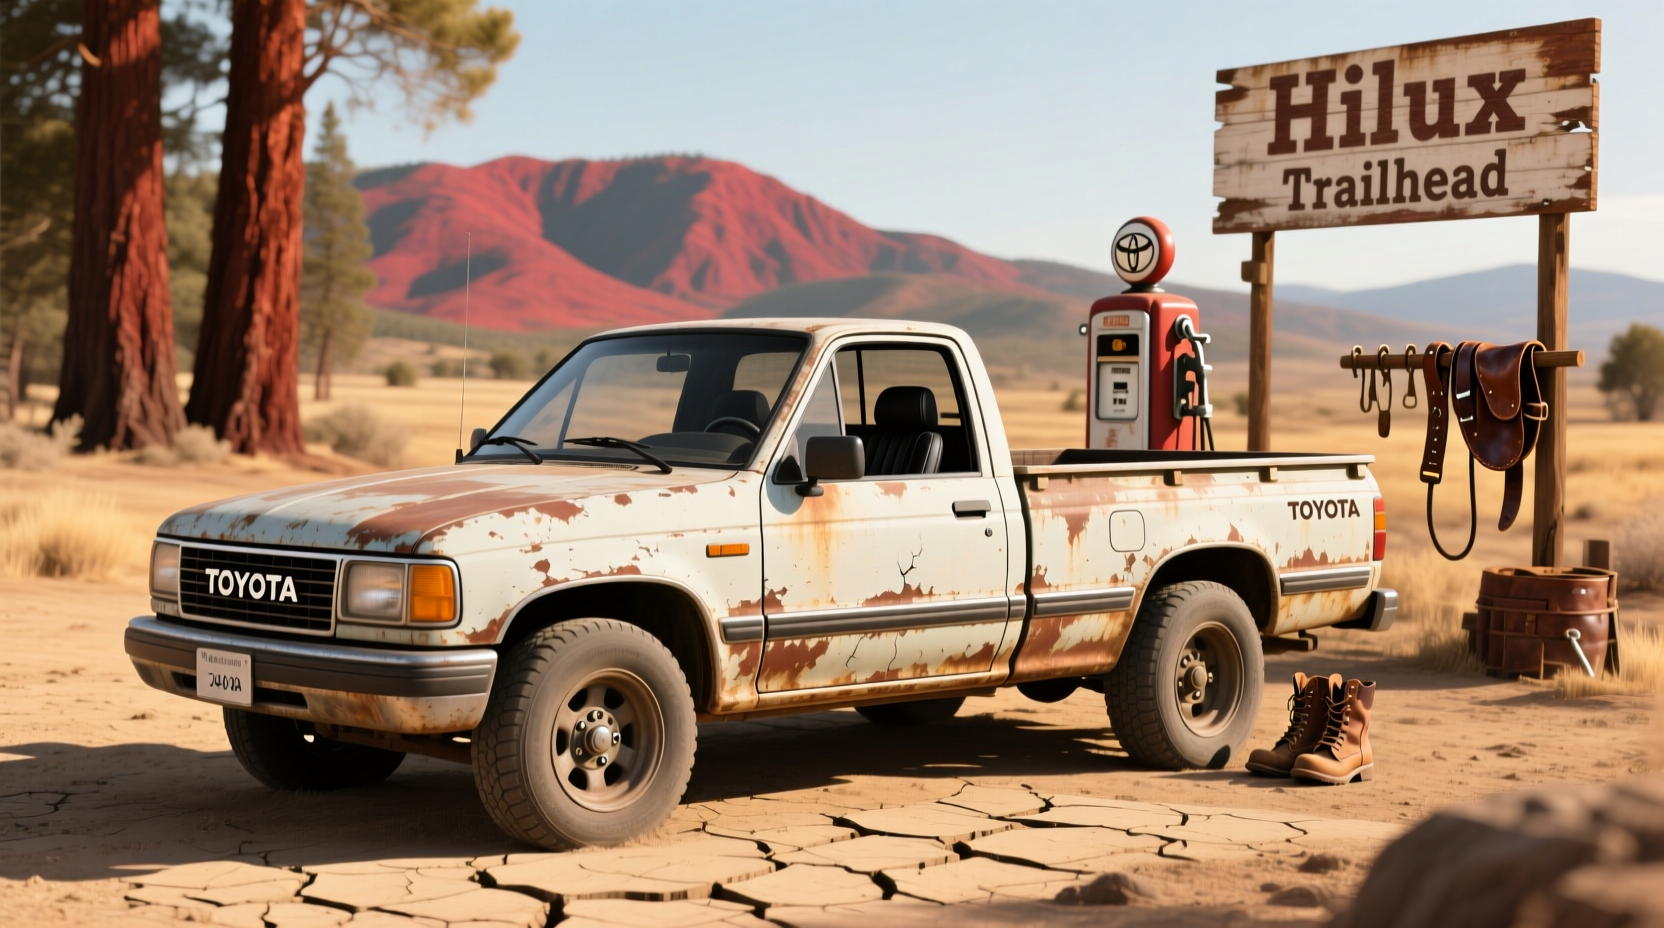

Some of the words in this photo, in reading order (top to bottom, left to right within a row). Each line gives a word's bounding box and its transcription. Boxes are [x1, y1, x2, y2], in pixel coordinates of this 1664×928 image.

[1268, 59, 1526, 155] Hilux
[1282, 148, 1509, 211] Trailhead
[1287, 499, 1361, 520] TOYOTA
[205, 568, 298, 603] TOYOTA
